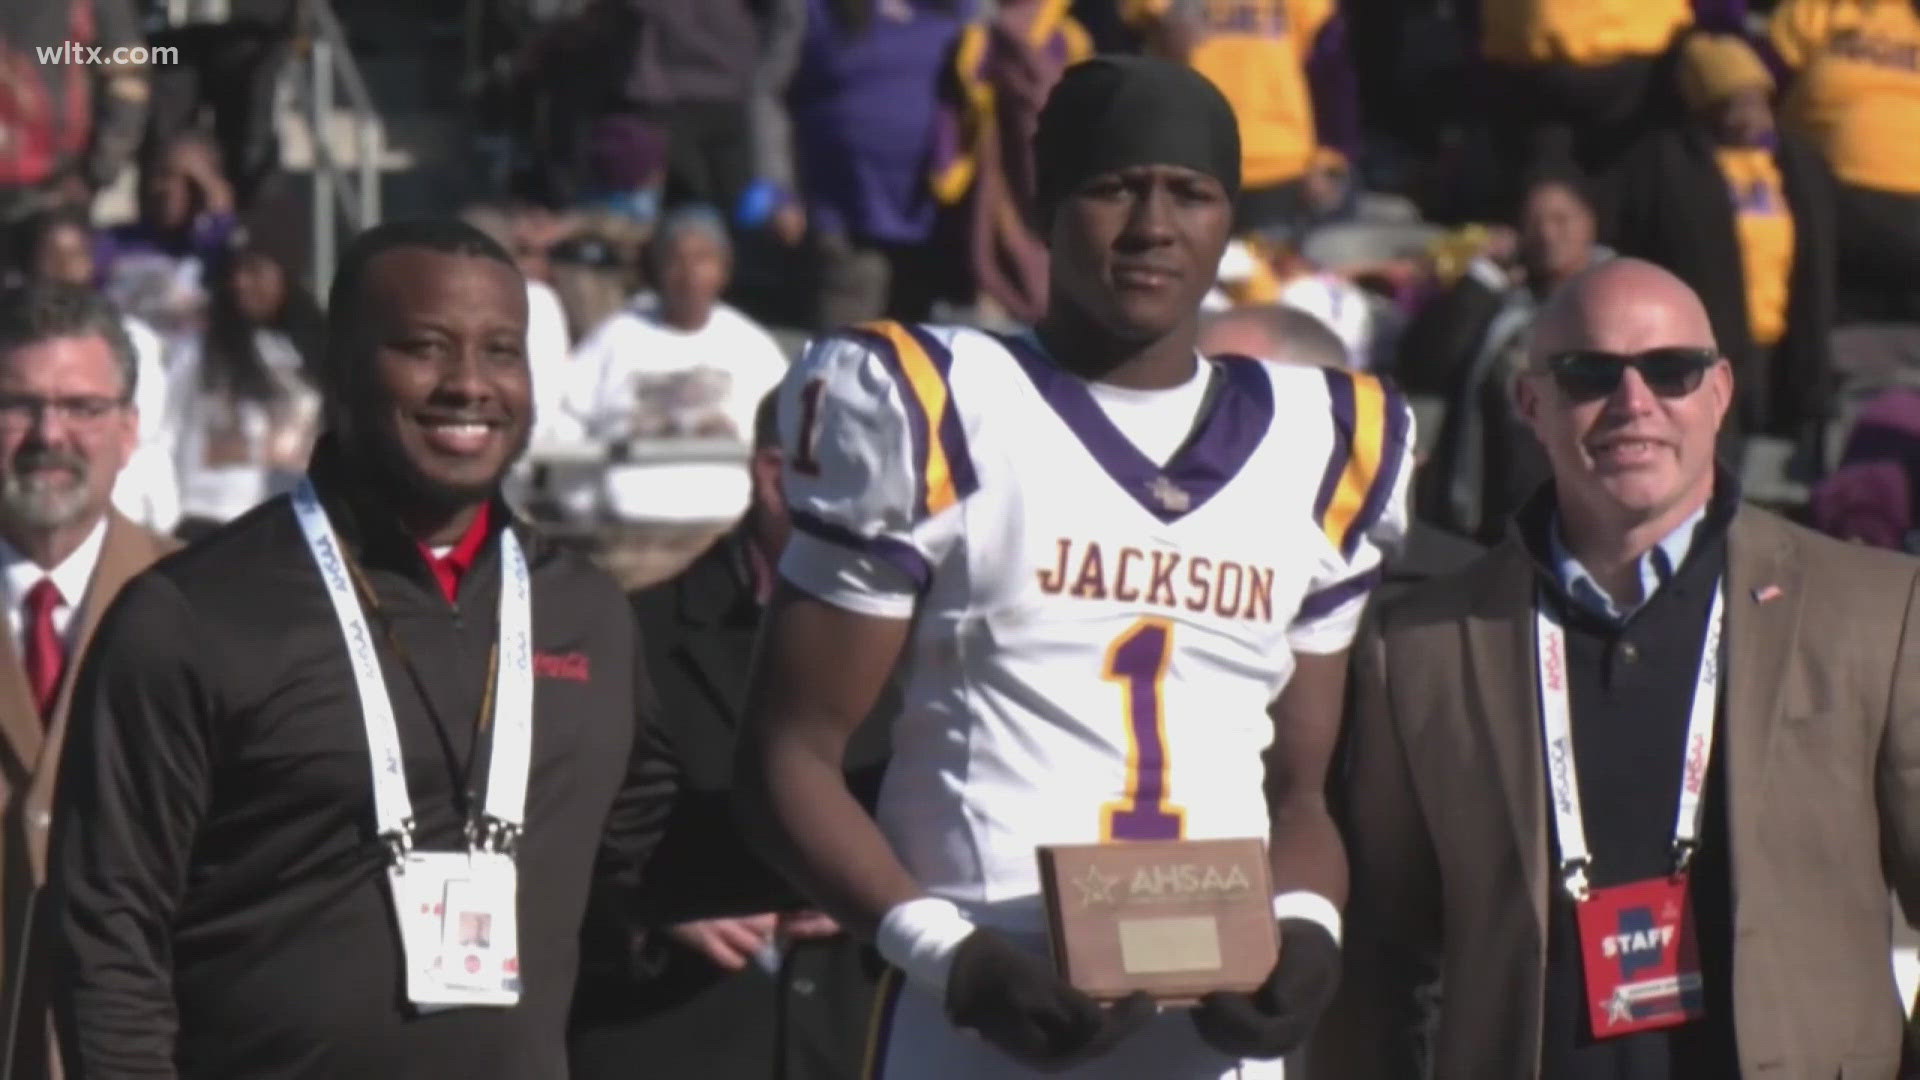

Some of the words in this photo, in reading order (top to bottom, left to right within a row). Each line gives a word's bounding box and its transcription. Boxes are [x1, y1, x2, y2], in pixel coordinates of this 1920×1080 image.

[792, 379, 824, 477] 1
[1036, 538, 1275, 623] JACKSON
[1100, 616, 1187, 842] 1
[1131, 864, 1250, 896] AHSAA
[1601, 925, 1674, 958] STAFF
